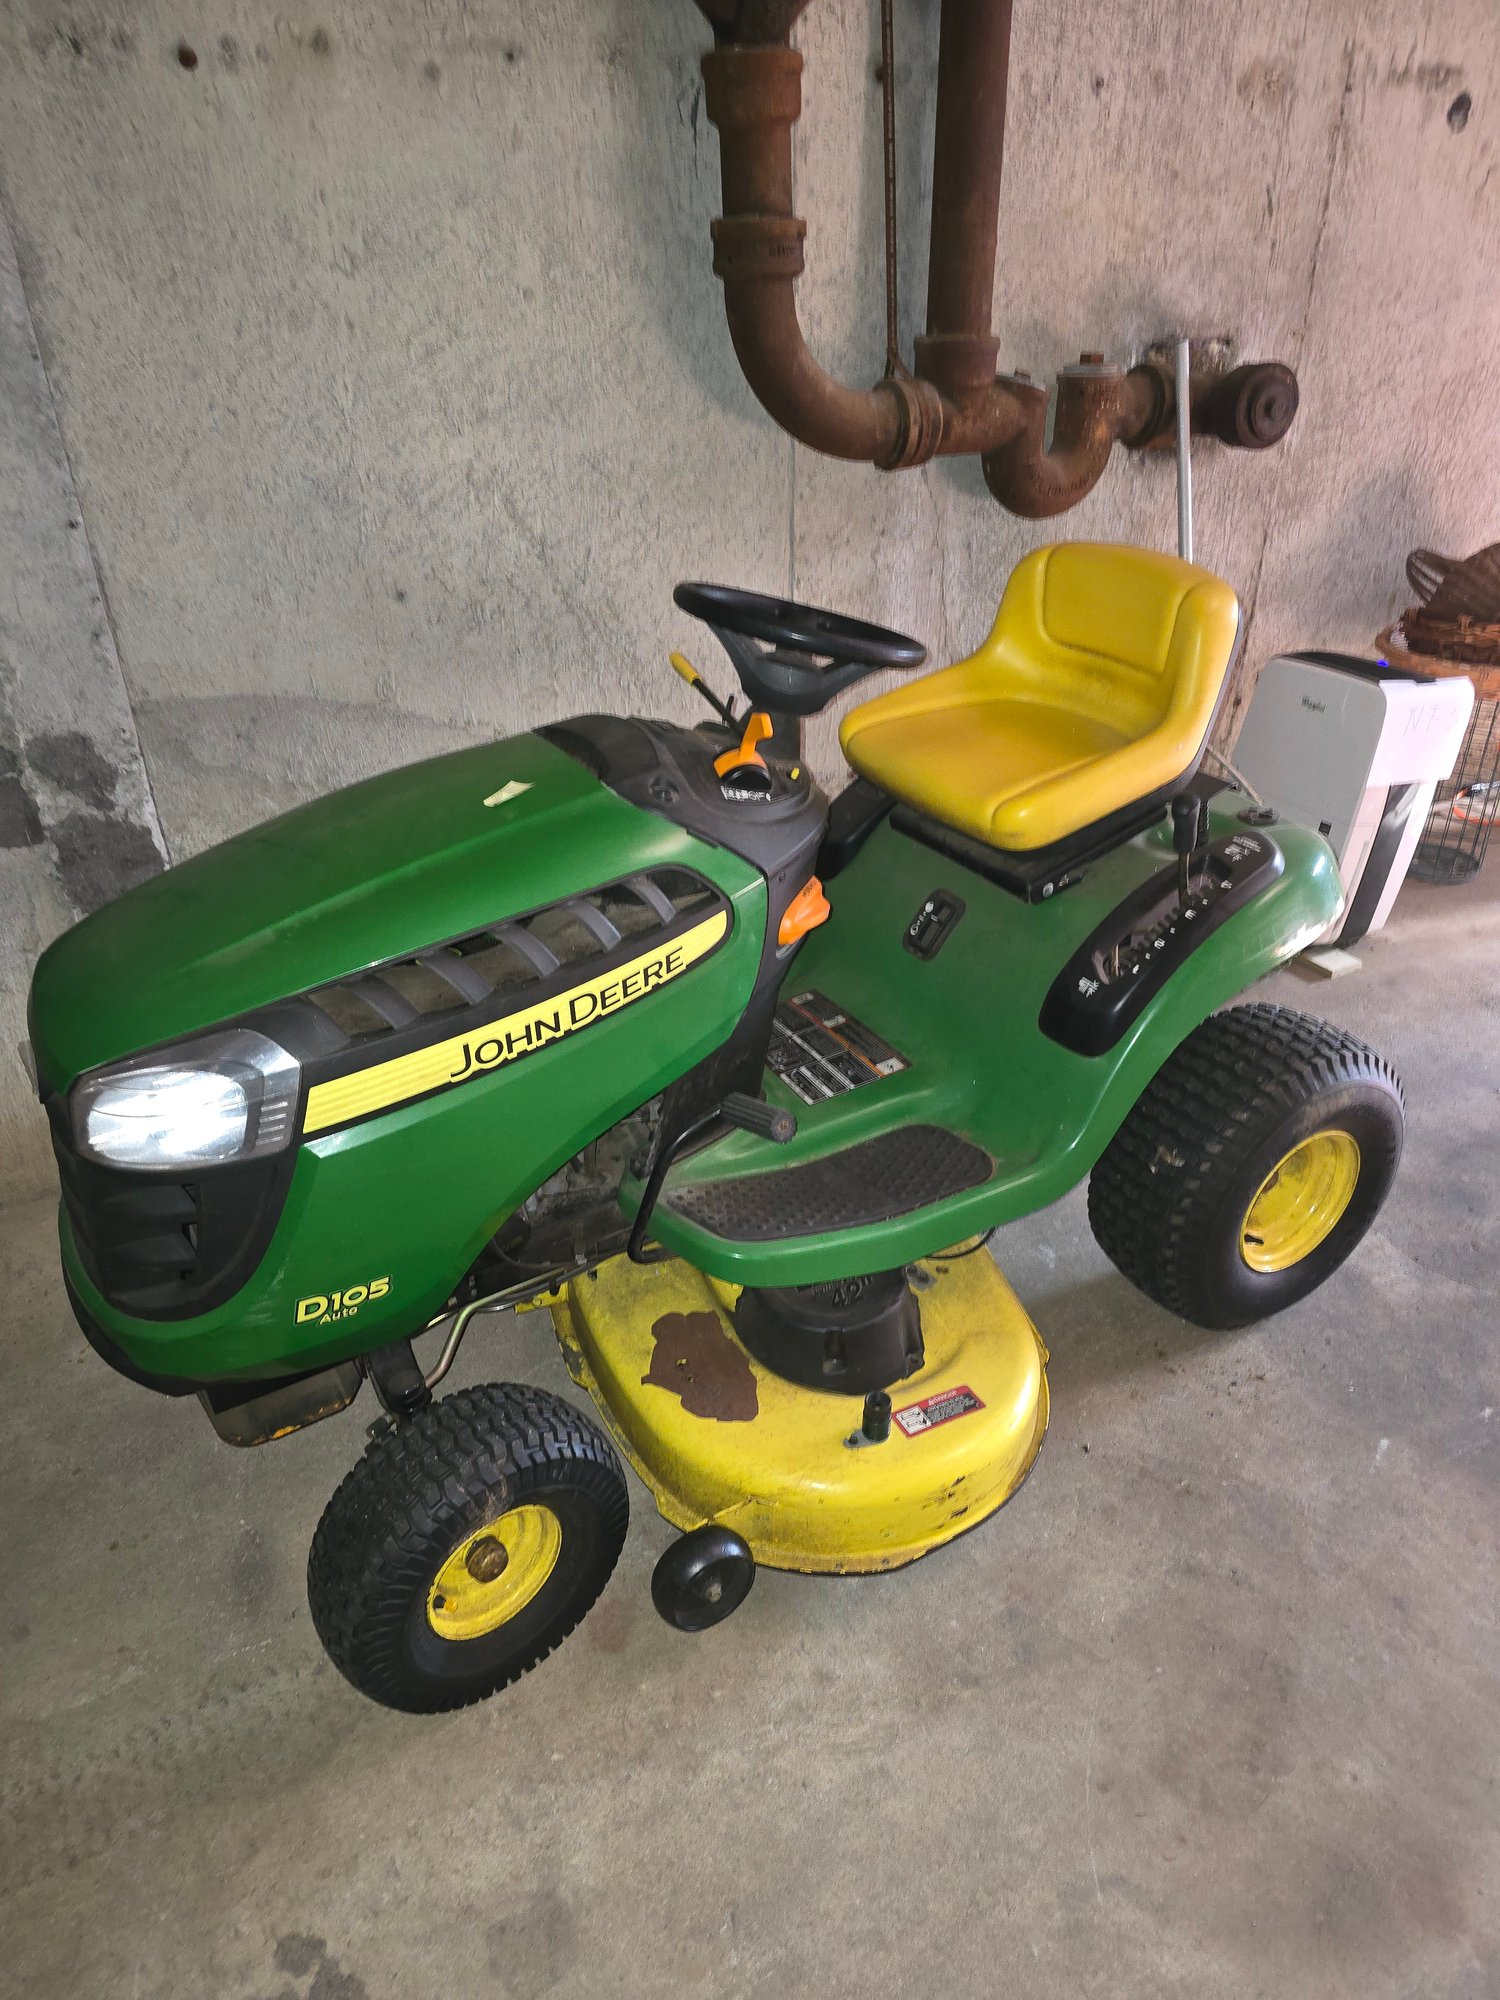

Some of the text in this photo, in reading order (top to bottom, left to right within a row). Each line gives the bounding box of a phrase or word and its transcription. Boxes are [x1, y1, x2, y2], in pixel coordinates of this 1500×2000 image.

[450, 945, 684, 1078] JOHN DEERE
[295, 1275, 392, 1325] D105
